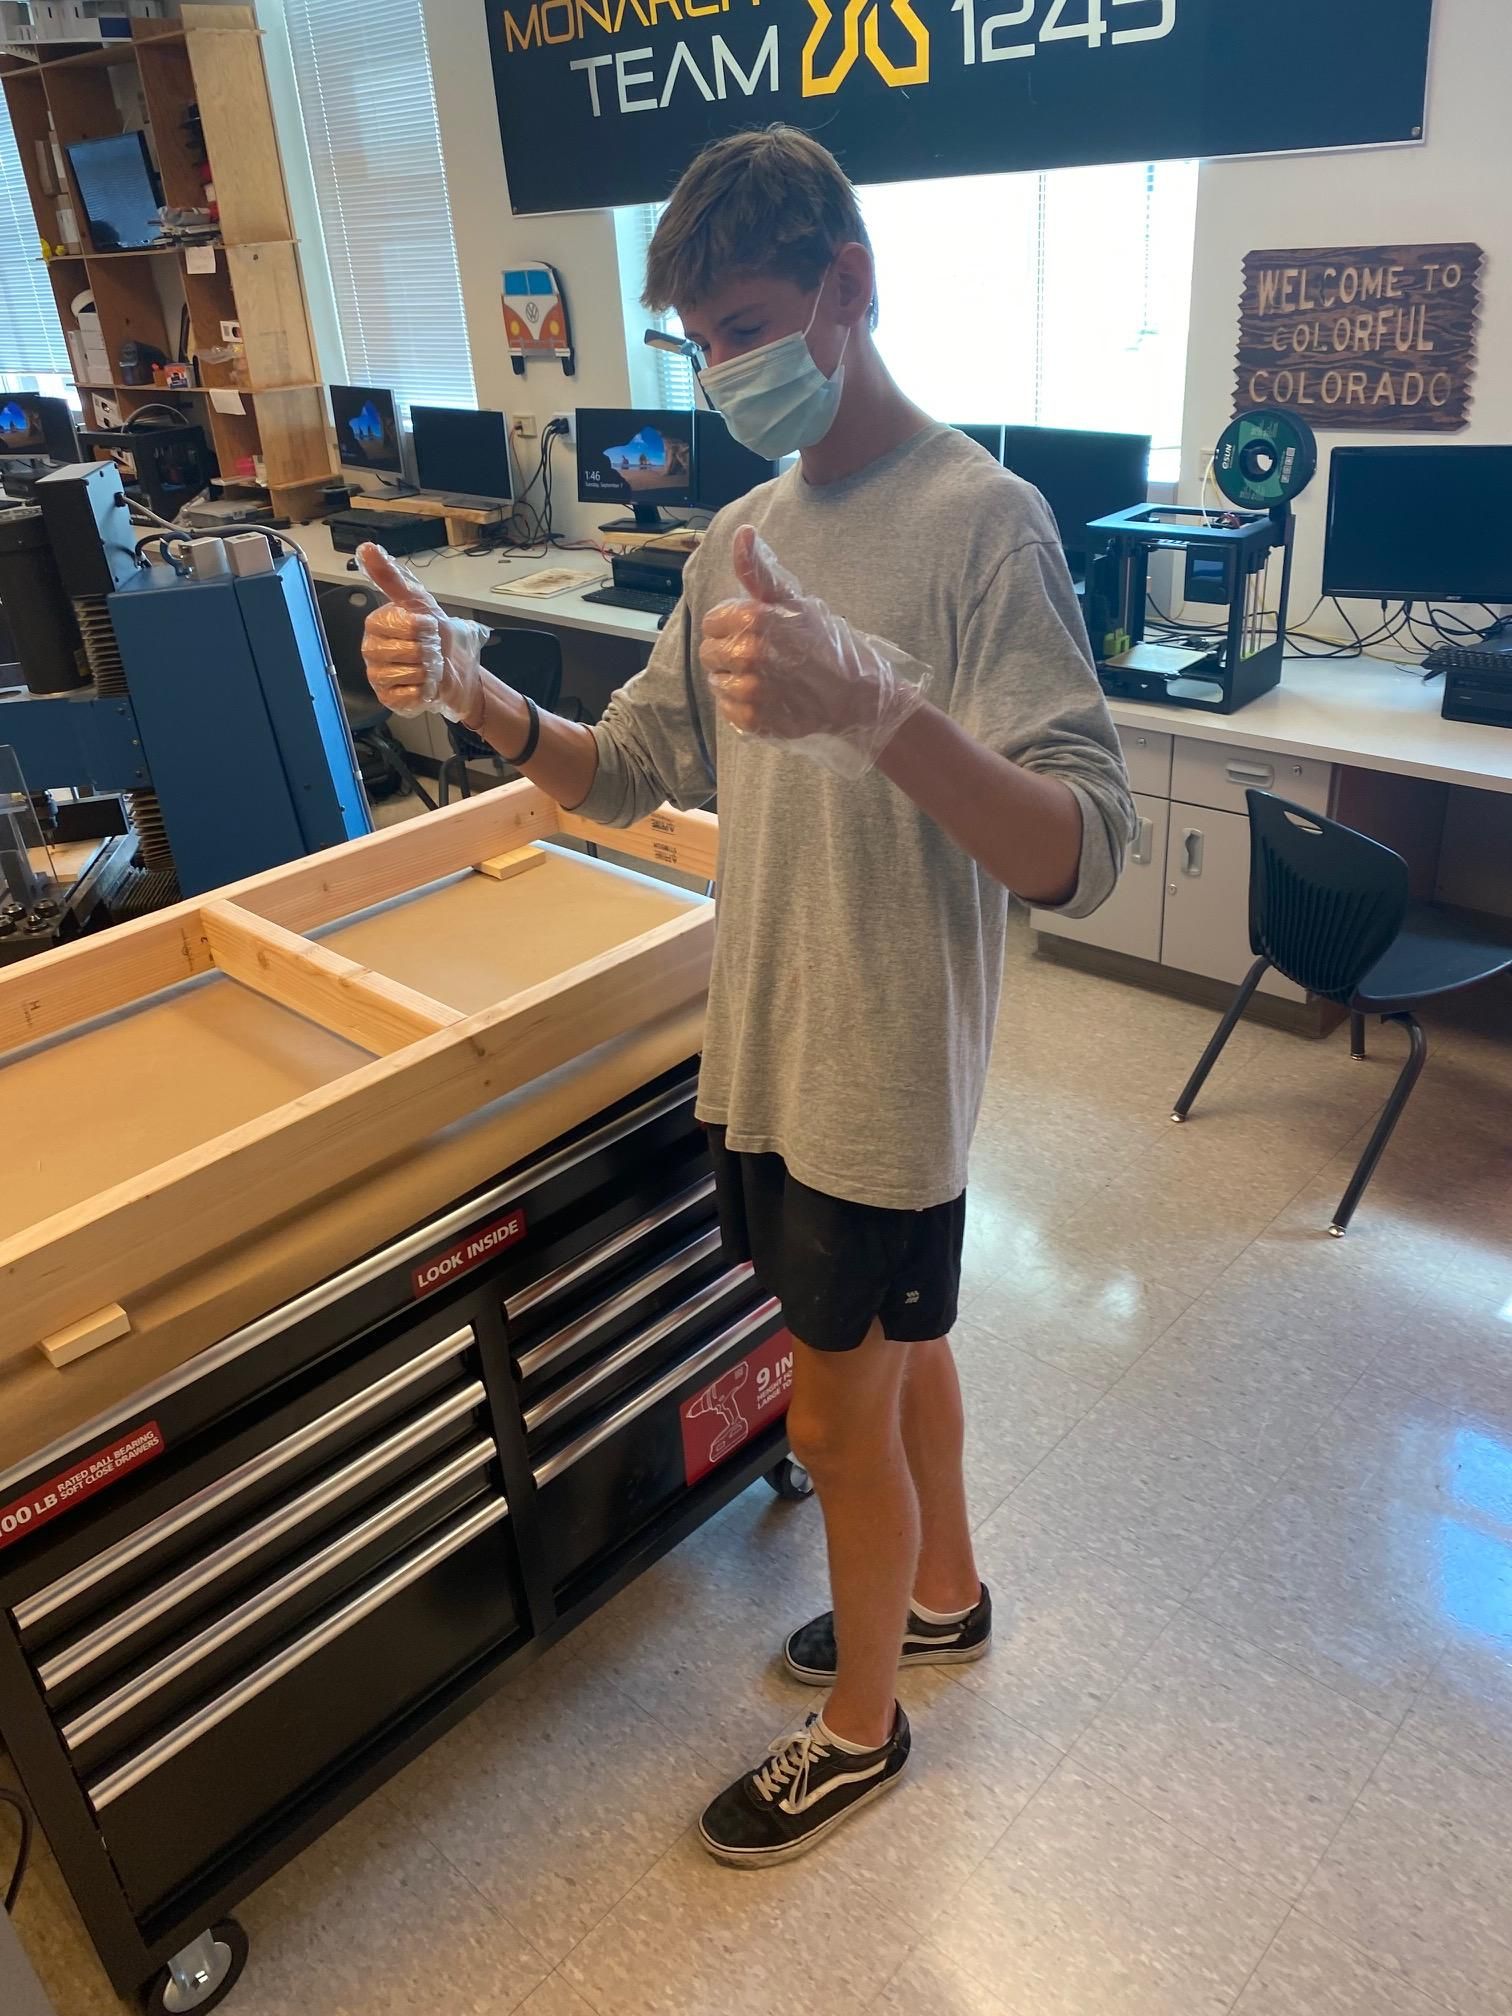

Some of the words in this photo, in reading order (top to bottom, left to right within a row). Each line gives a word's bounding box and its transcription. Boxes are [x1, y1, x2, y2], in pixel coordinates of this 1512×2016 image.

[951, 0, 1176, 65] 1245
[570, 24, 779, 117] TEAM
[1258, 265, 1404, 316] WELCOME
[1423, 264, 1462, 292] TO
[1271, 304, 1434, 352] COLORFUL
[1249, 370, 1451, 406] COLORADO
[417, 1252, 464, 1288] LOOK
[466, 1220, 519, 1259] INSIDE
[756, 1367, 770, 1392] 9
[57, 1470, 88, 1492] RATED
[89, 1456, 113, 1473] BALL
[113, 1431, 154, 1458] BEARING
[60, 1484, 84, 1500] SOFT
[85, 1465, 115, 1485] CLOSE
[115, 1437, 160, 1466] DRAWERS
[0, 1506, 32, 1537] 00
[34, 1494, 58, 1515] LB
